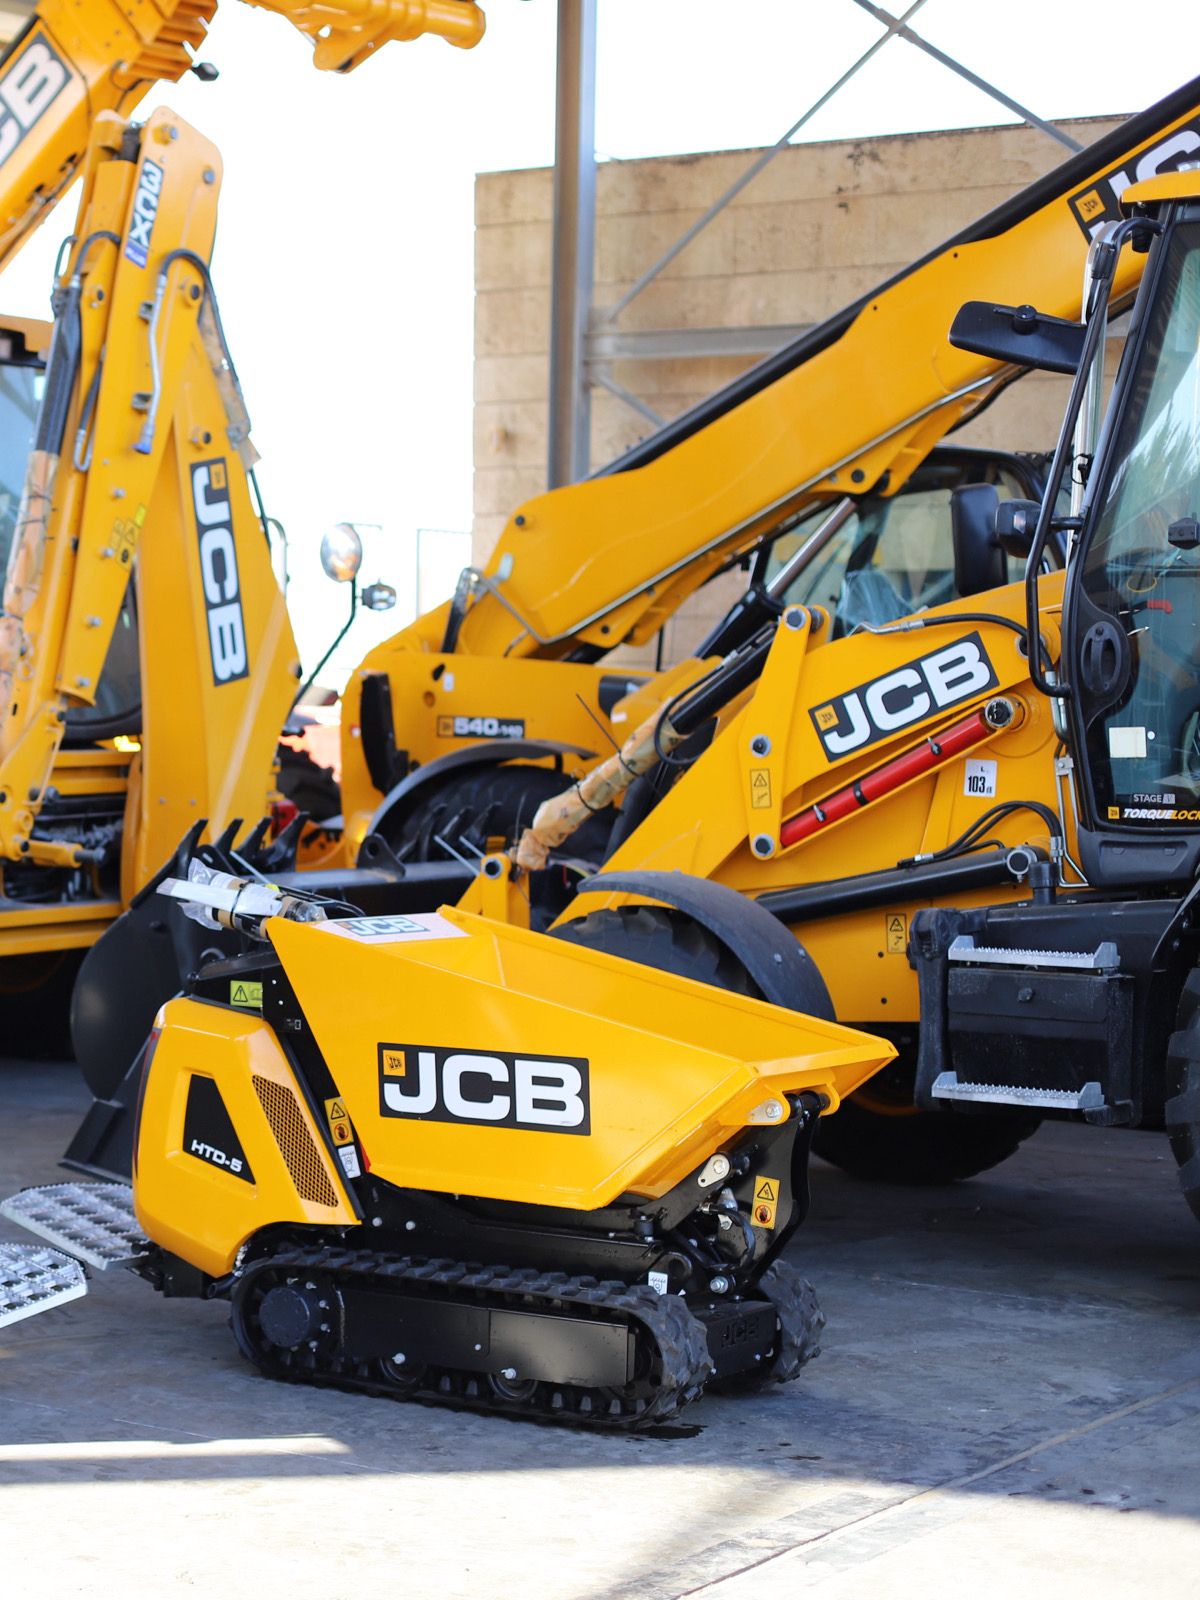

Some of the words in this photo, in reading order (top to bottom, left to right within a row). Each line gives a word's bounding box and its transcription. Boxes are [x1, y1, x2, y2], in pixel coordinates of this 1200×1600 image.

[128, 161, 163, 248] 3CX
[193, 466, 247, 681] JCB
[823, 641, 991, 754] JCB
[968, 776, 986, 793] 103
[1133, 793, 1162, 803] STAGE
[351, 917, 426, 935] JCB
[384, 1051, 585, 1127] JCB
[190, 1139, 243, 1173] HTD-5
